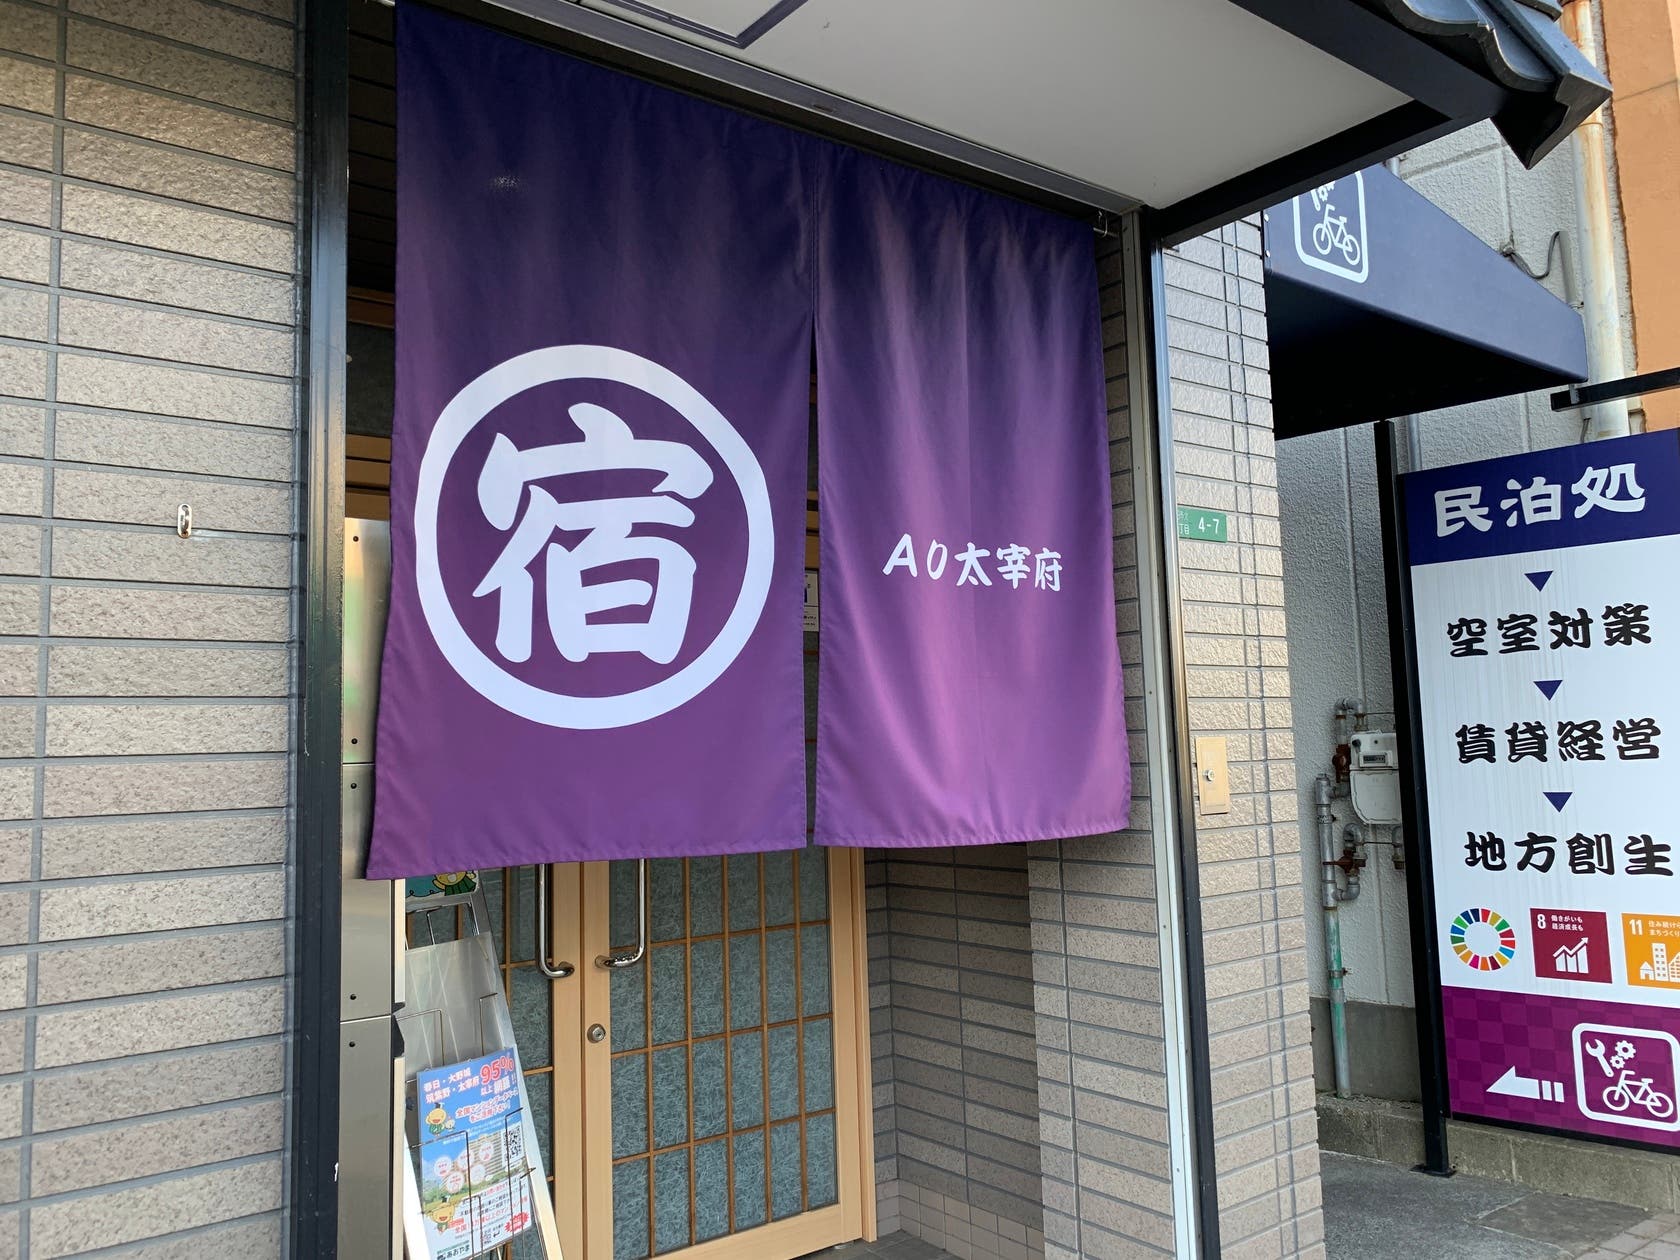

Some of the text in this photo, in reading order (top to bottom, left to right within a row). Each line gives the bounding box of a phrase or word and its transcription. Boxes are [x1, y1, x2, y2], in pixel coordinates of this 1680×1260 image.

[1434, 463, 1646, 538] 民泊処
[472, 402, 714, 664] 宿
[1198, 516, 1220, 535] 4-7
[1446, 603, 1652, 658] 空室対策
[1455, 717, 1662, 764] 賃貸経営
[1464, 831, 1674, 876] 地方創生
[1536, 913, 1583, 929] 8 働きがいも
[1552, 923, 1584, 932] 経済成長も
[1629, 919, 1643, 936] 11
[480, 1055, 514, 1086] 95%
